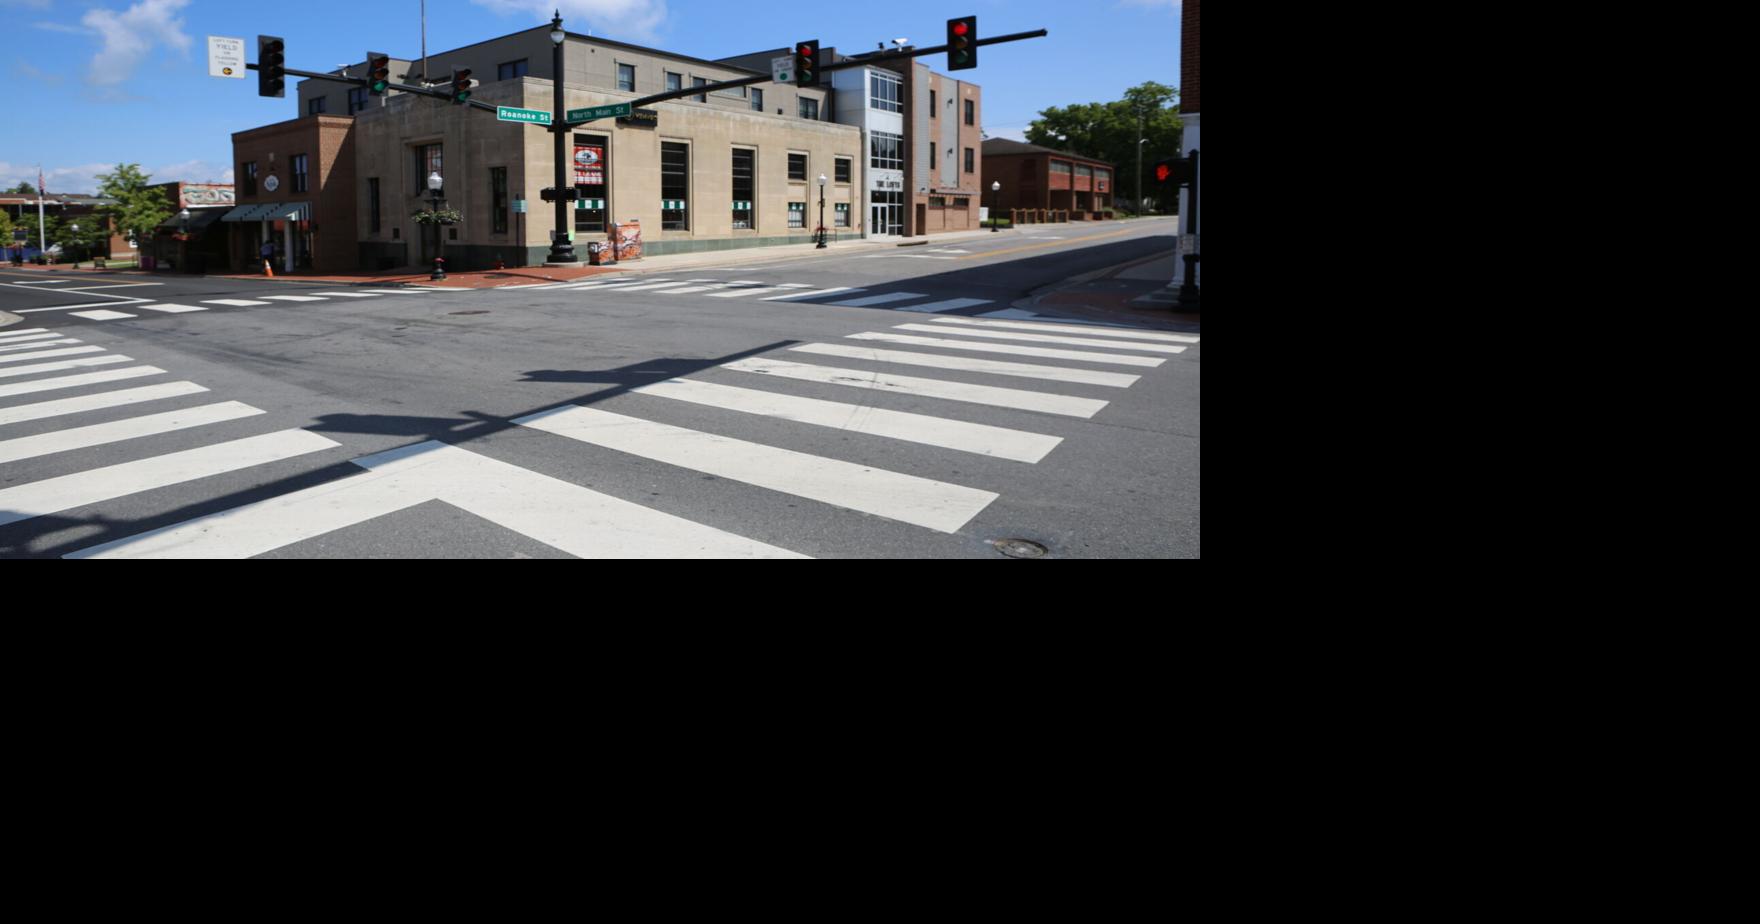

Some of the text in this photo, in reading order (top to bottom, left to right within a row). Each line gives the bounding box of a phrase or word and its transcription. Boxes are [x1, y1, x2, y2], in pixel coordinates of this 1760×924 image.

[216, 43, 238, 51] YIELD
[500, 109, 549, 121] Roanoke St
[572, 111, 591, 119] North
[615, 106, 624, 114] St
